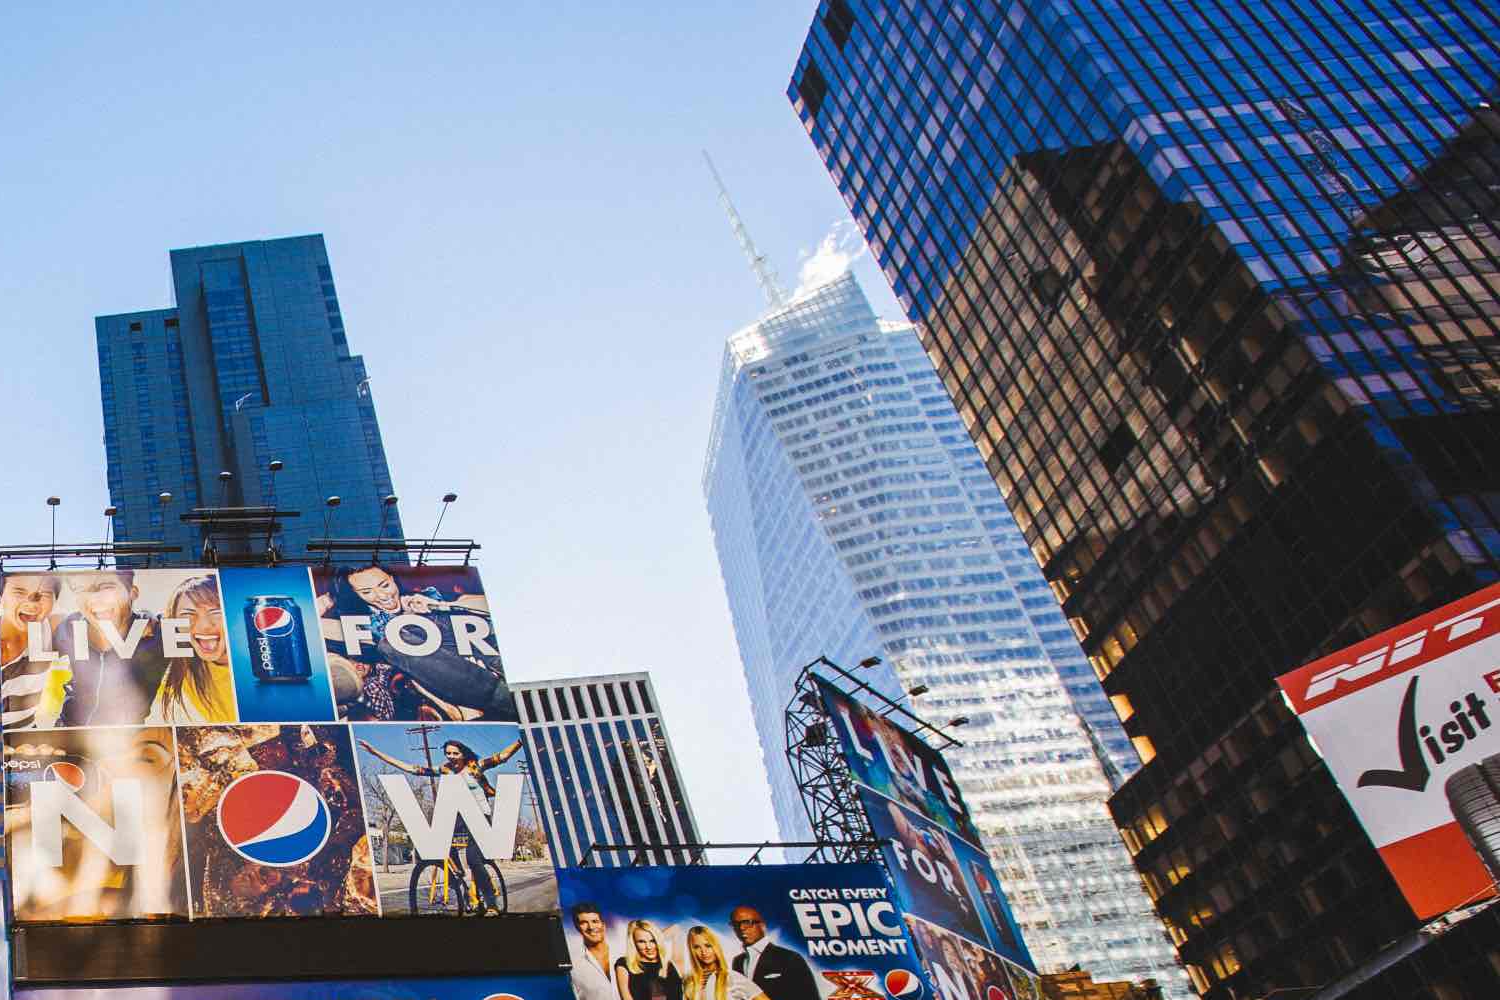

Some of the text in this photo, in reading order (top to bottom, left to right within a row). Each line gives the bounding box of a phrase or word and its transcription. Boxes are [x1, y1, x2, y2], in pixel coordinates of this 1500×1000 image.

[27, 618, 195, 661] LIVE
[261, 635, 274, 671] pepsi
[342, 613, 497, 656] FOR
[1356, 675, 1492, 793] Visit
[1, 758, 41, 770] pepsi
[840, 705, 962, 814] LIVE
[891, 839, 957, 894] FOR
[789, 888, 887, 900] CATCH EVERY
[792, 902, 902, 937] EPIC
[807, 939, 907, 956] MOMENT
